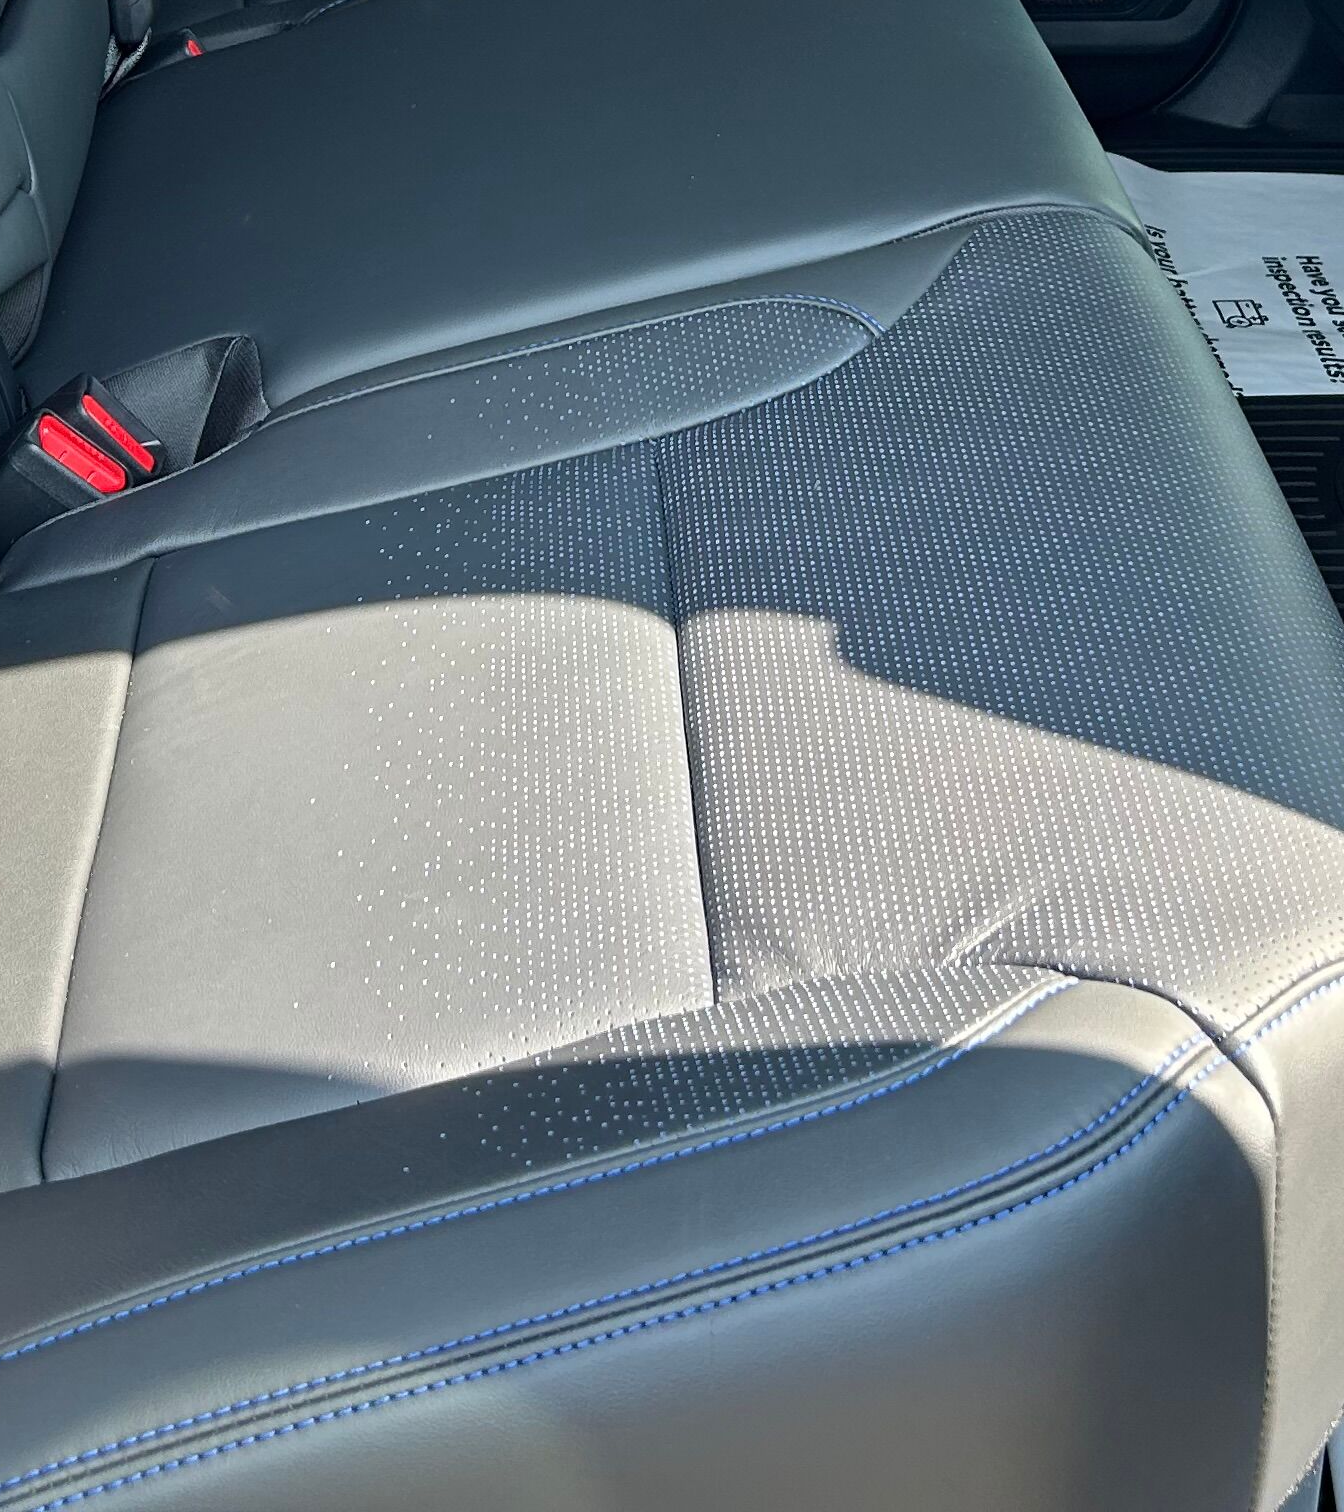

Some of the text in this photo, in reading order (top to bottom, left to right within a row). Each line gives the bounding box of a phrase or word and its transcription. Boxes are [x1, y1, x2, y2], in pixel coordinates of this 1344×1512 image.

[1144, 223, 1167, 239] Is
[1149, 238, 1179, 276] your
[1295, 254, 1330, 287] Have
[1261, 255, 1317, 333] inspection
